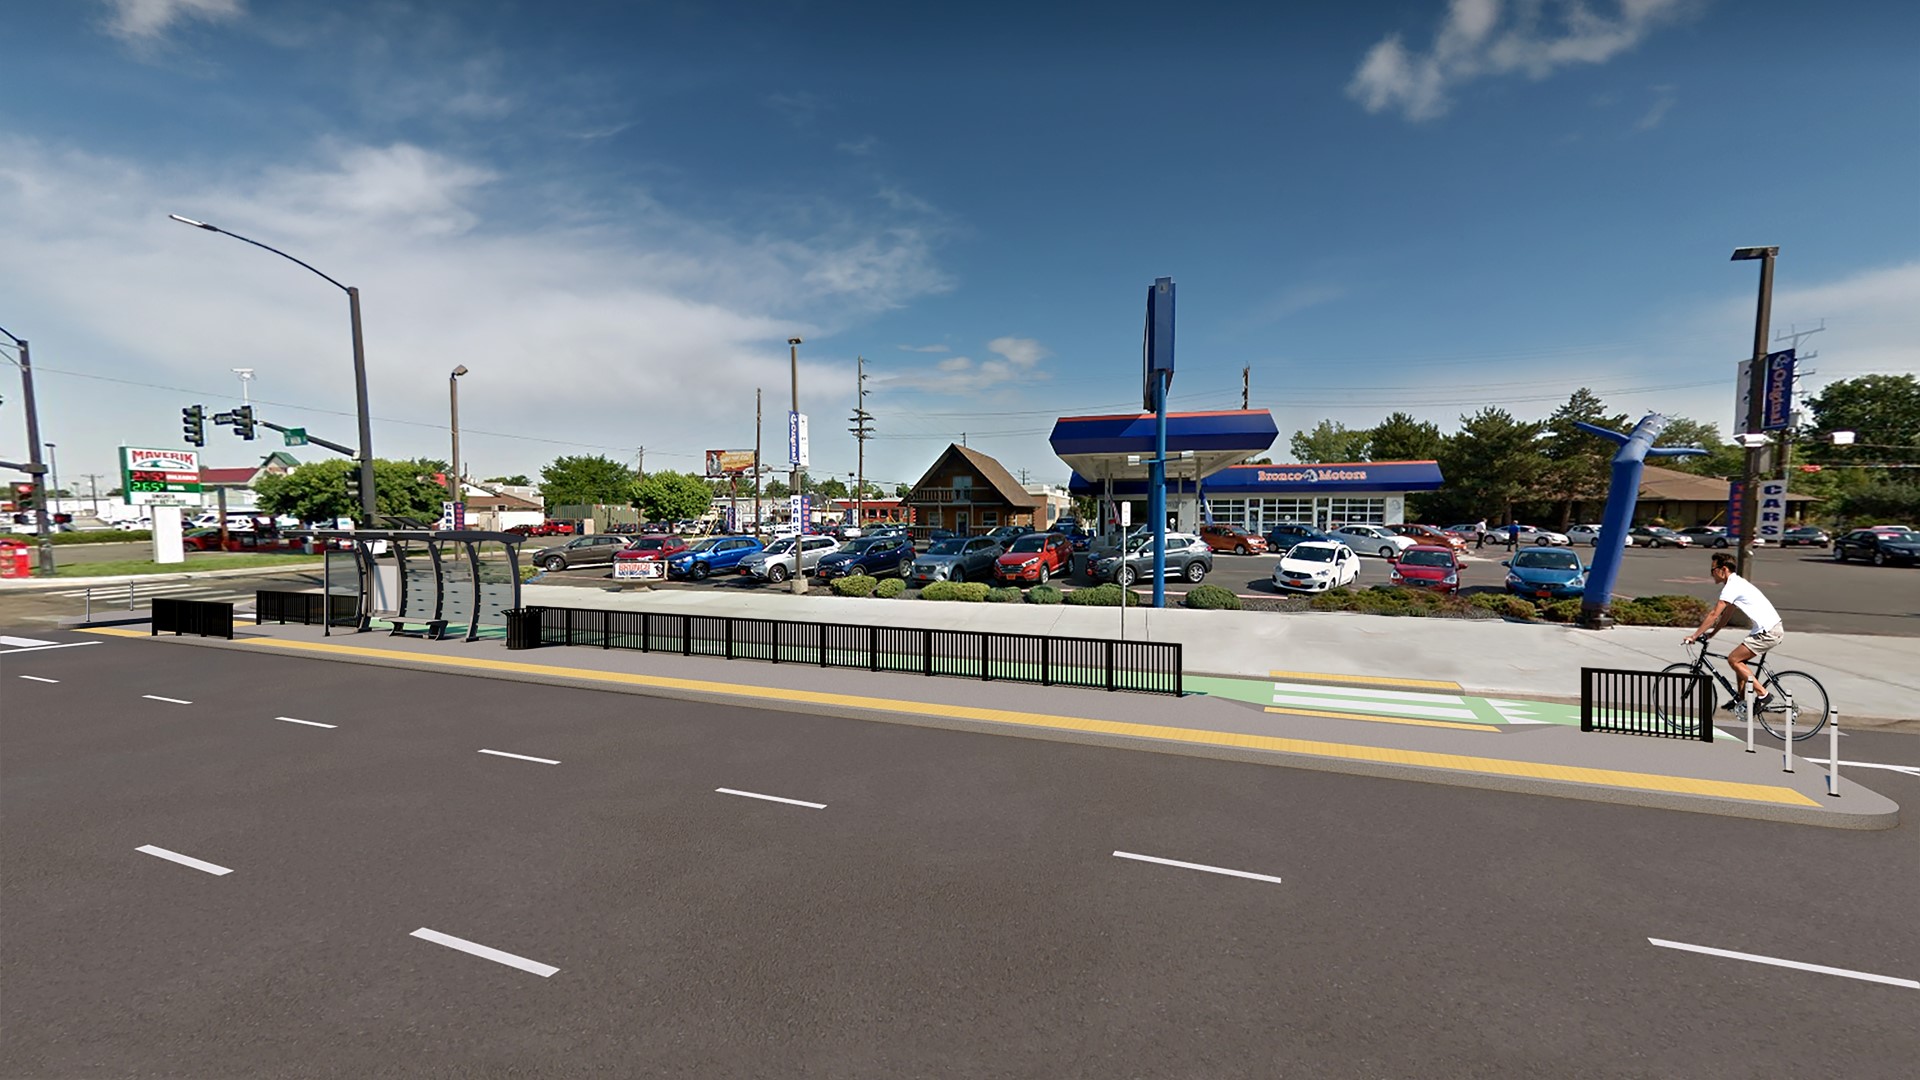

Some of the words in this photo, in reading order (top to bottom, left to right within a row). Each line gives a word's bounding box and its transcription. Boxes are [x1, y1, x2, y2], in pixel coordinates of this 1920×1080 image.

[1769, 369, 1787, 425] Original
[132, 450, 194, 466] MAVERIK
[1258, 470, 1303, 481] Bronco
[1318, 469, 1367, 480] Motors
[1761, 485, 1782, 535] CARS
